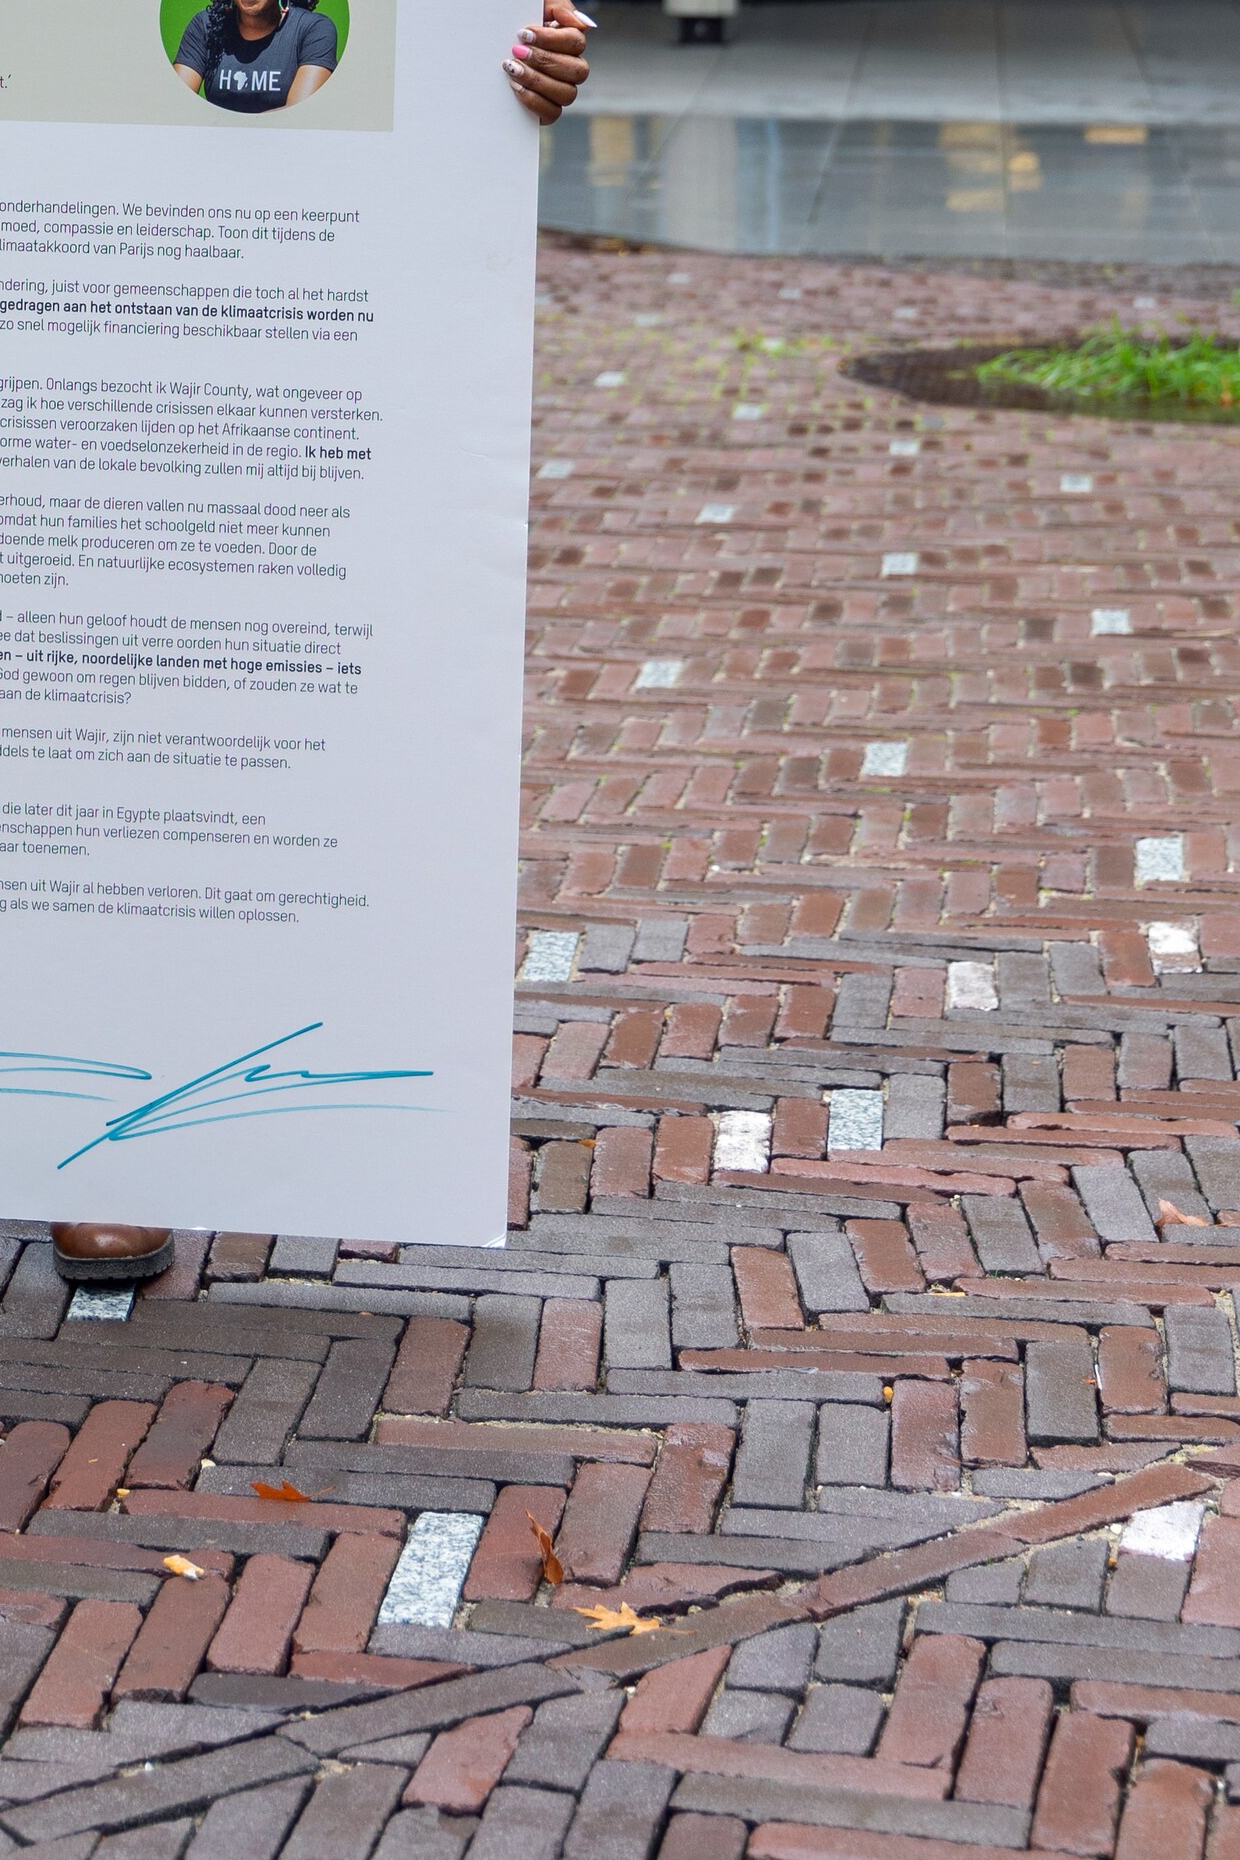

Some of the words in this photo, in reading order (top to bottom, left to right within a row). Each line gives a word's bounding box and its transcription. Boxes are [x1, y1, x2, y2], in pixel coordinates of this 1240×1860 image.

[121, 202, 143, 217] We
[145, 202, 205, 218] bevinden
[207, 207, 232, 219] ons
[234, 208, 251, 220] nu
[254, 209, 271, 223] op
[273, 209, 298, 221] een
[301, 207, 360, 225] keerpunt
[92, 243, 116, 255] van
[119, 241, 154, 259] Parijs
[156, 245, 181, 260] nog
[184, 243, 244, 259] haalbaar.
[62, 301, 87, 313] aan
[89, 299, 112, 314] het
[114, 301, 173, 316] ontstaan
[175, 305, 199, 317] van
[201, 303, 218, 317] de
[220, 304, 304, 320] klimaatcrisis
[306, 307, 354, 322] worden
[357, 311, 374, 323] nu
[52, 458, 76, 470] van
[79, 456, 95, 470] de
[98, 457, 137, 472] lokale
[139, 458, 202, 477] bevolking
[203, 461, 243, 475] zullen
[245, 462, 264, 479] mij
[266, 463, 299, 481] altijd
[301, 464, 316, 482] bij
[319, 464, 364, 483] blijven.
[43, 572, 69, 589] zijn.
[21, 840, 90, 856] toenemen.
